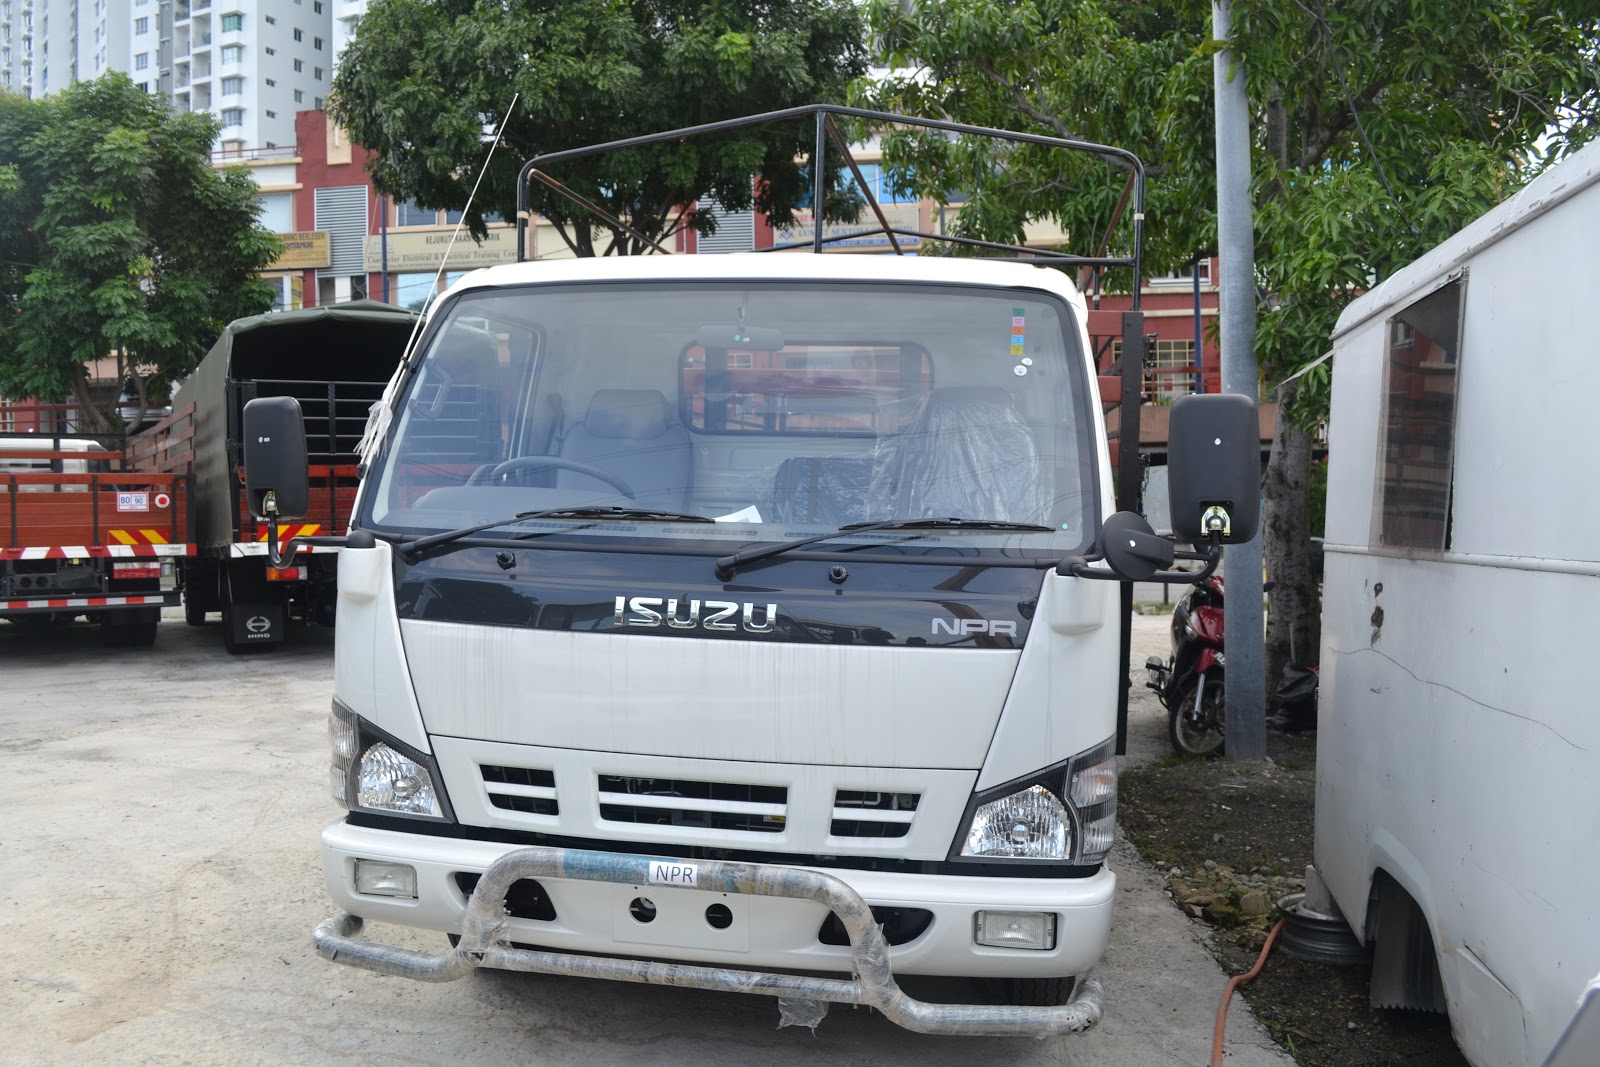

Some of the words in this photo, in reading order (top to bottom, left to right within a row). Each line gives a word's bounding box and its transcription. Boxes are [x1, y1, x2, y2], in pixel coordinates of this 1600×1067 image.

[614, 596, 778, 634] ISUZU
[931, 617, 1018, 638] NPR
[656, 865, 693, 884] NPR
